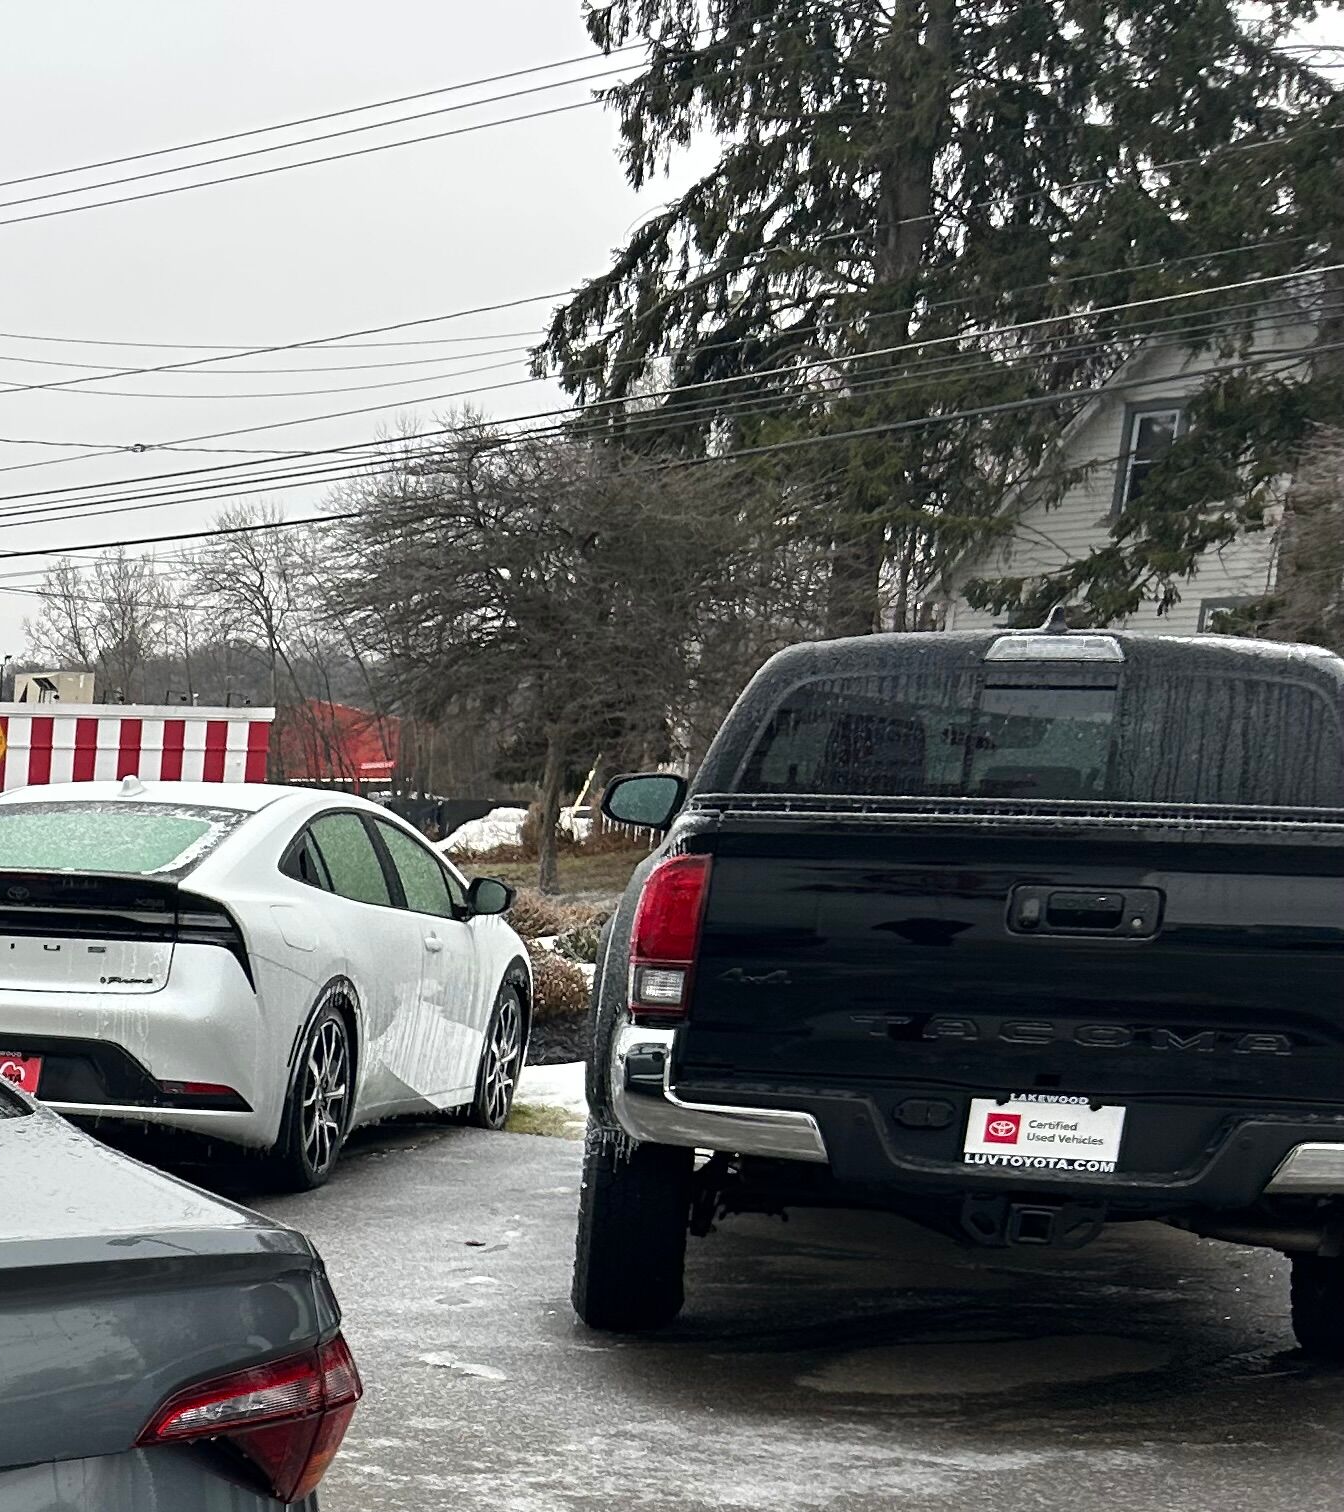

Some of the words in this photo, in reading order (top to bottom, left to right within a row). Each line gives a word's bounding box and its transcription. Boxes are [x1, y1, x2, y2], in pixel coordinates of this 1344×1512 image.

[850, 1014, 1292, 1056] TACOMA
[1010, 1093, 1089, 1105] LAKEWOOD
[1028, 1119, 1079, 1132] Certified
[1026, 1133, 1055, 1143] Used
[1058, 1134, 1104, 1146] Vehicles
[964, 1153, 1116, 1173] LUVTOYOTA.COM
